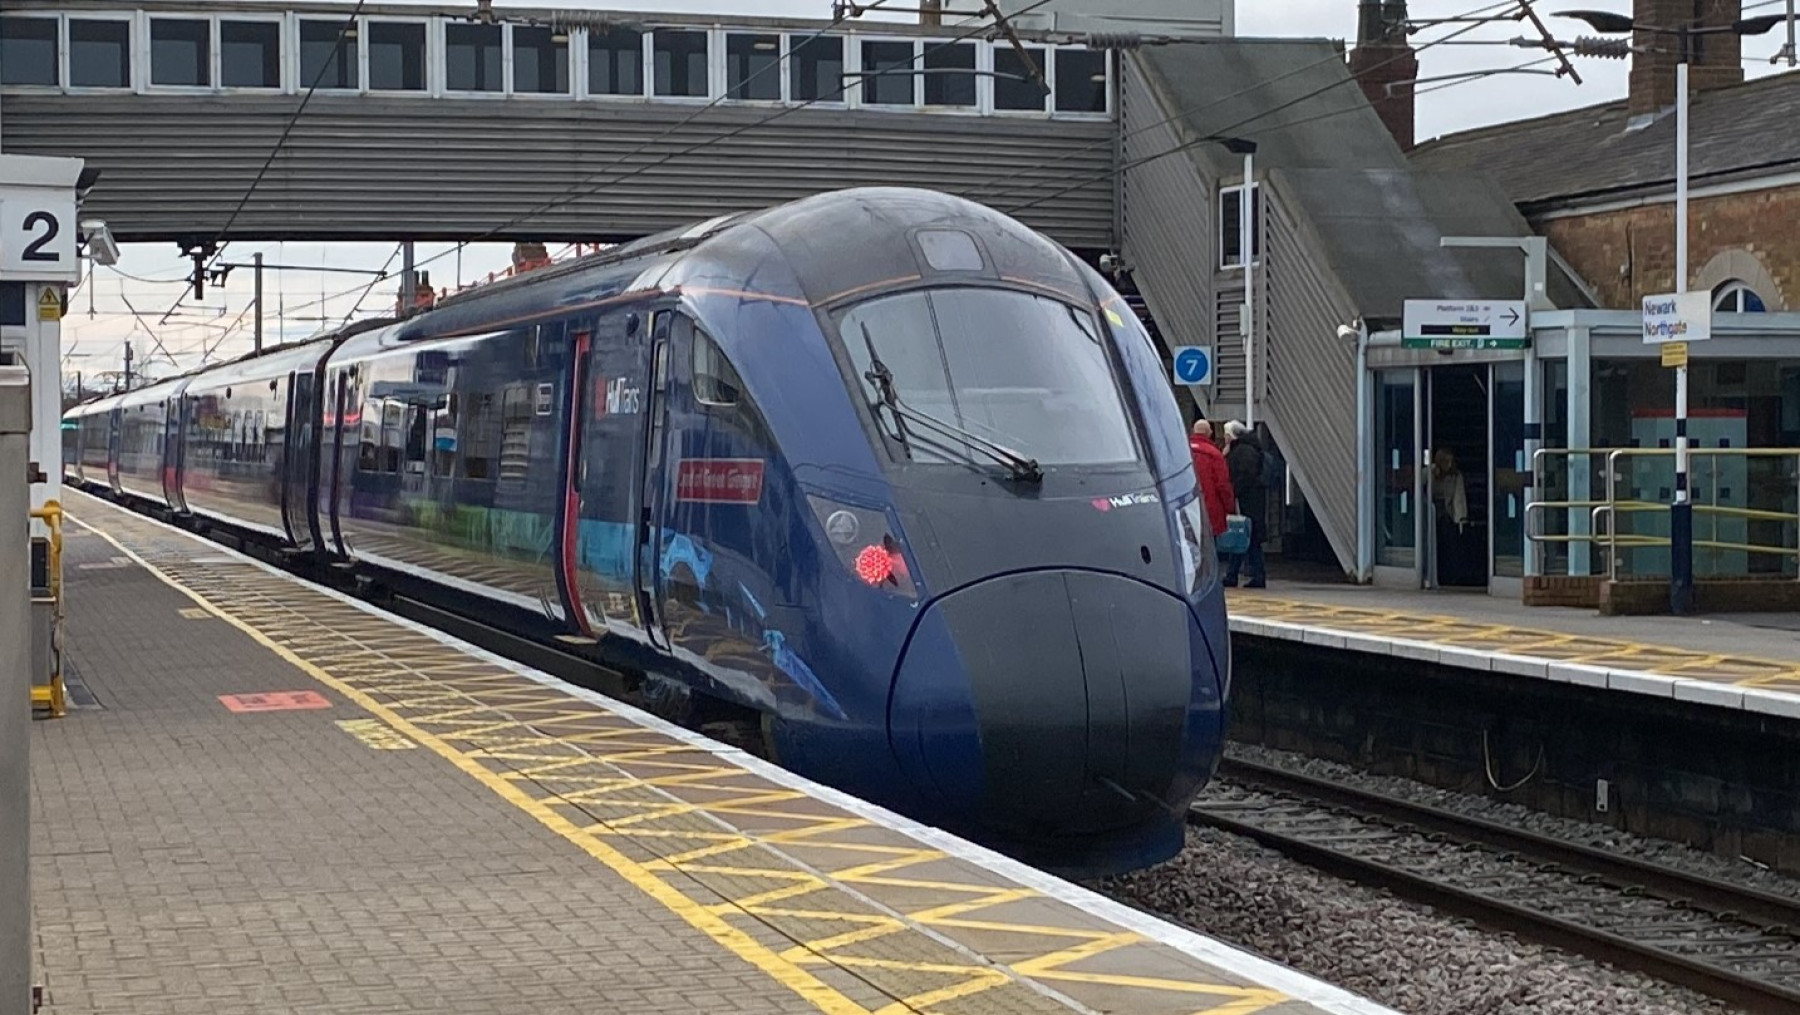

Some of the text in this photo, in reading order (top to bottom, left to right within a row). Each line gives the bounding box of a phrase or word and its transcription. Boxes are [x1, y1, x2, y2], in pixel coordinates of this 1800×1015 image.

[22, 210, 60, 262] 2
[1436, 304, 1465, 312] Platform
[1645, 299, 1677, 316] Newark
[1645, 320, 1687, 339] Northgate
[1431, 339, 1451, 348] FIRE
[1186, 359, 1198, 376] 7
